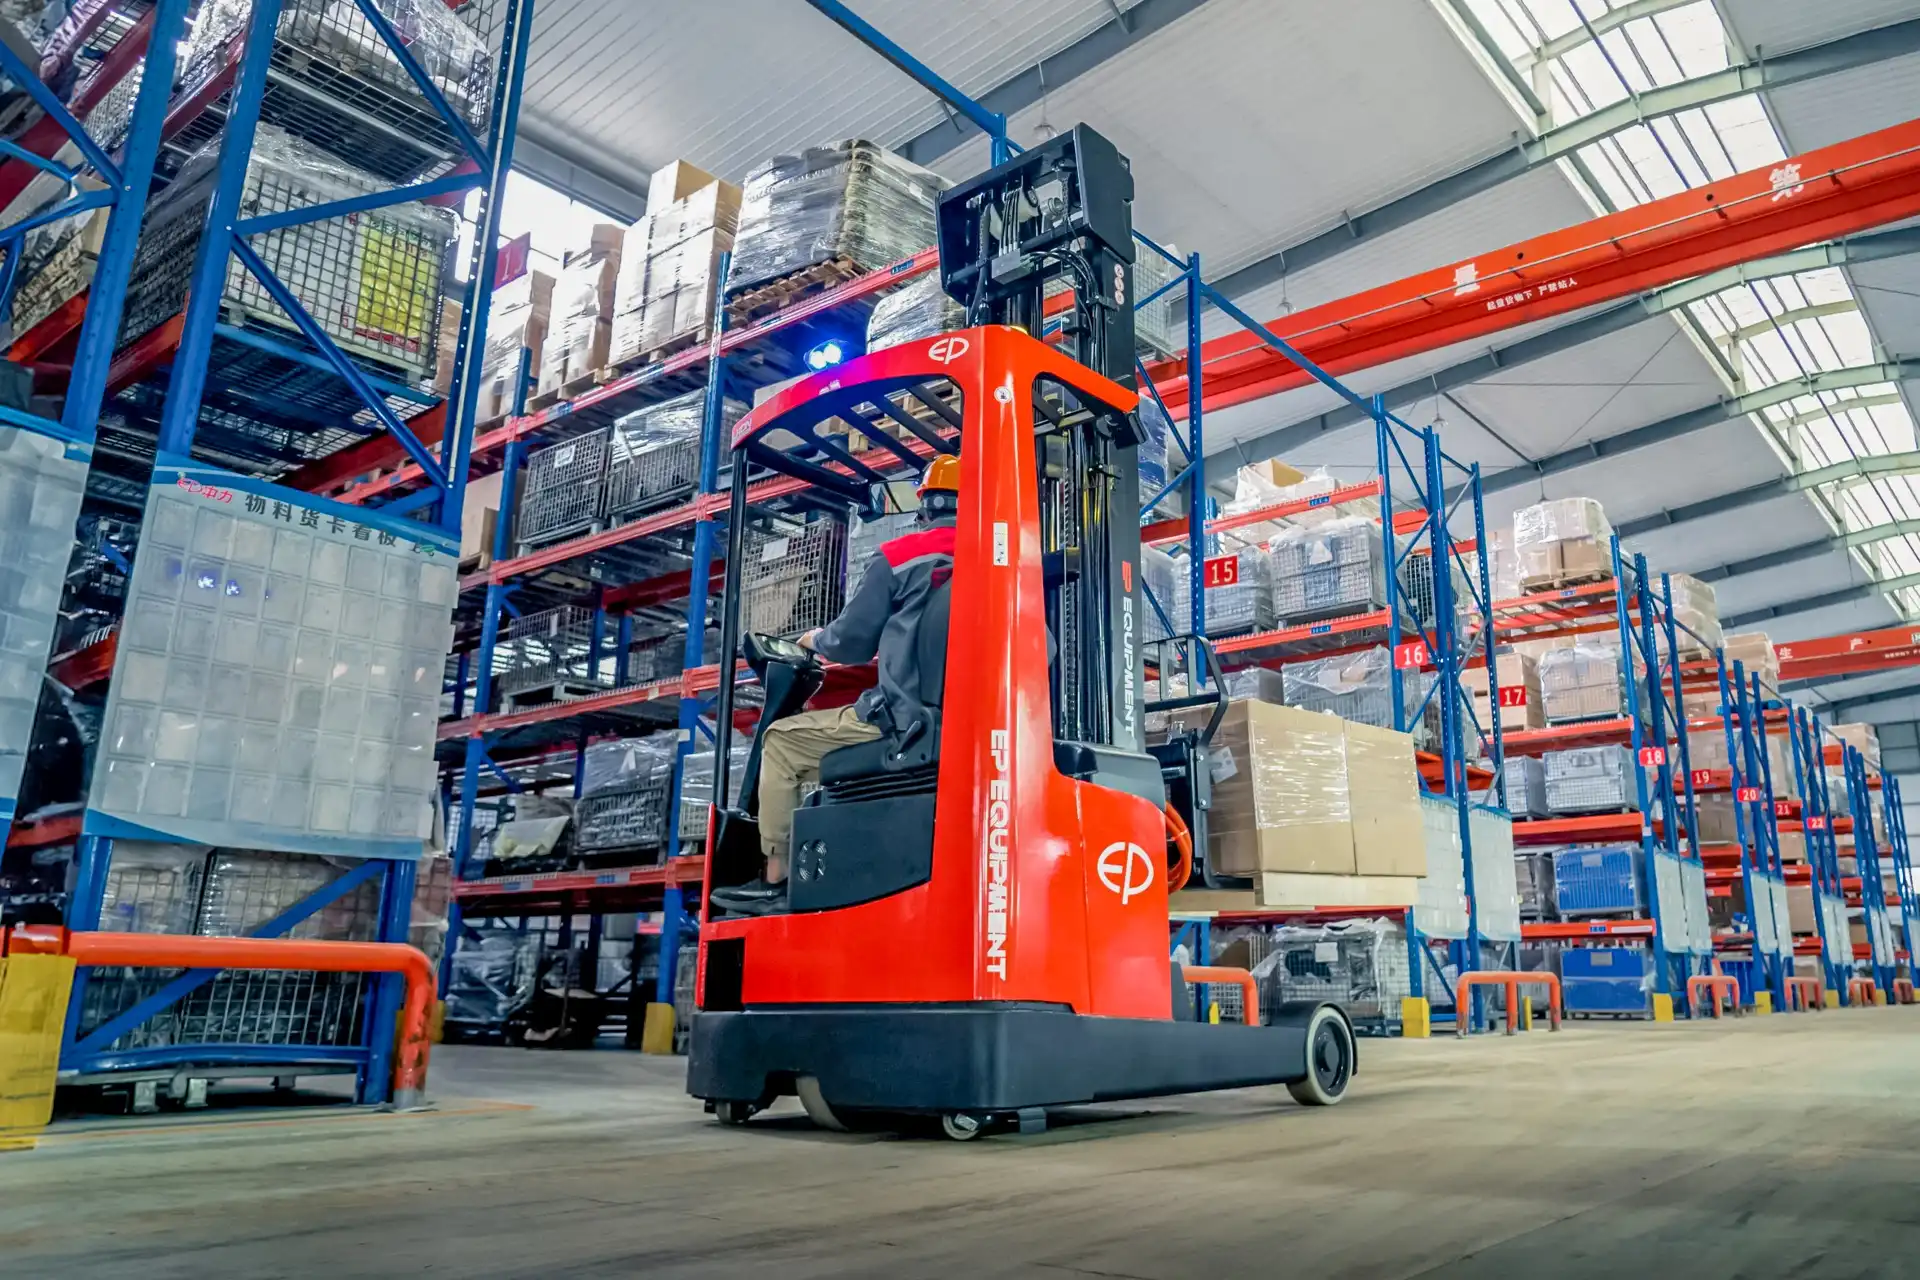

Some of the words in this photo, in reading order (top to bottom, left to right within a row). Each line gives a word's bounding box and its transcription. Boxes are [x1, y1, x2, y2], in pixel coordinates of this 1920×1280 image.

[929, 337, 969, 364] EP
[244, 494, 397, 548] 物料货卡看板
[1122, 561, 1132, 593] EP
[1211, 560, 1233, 584] 15
[1404, 645, 1423, 665] 16
[1124, 597, 1135, 739] EQUIPMENT
[1505, 688, 1522, 705] 17
[990, 729, 1008, 773] EP
[1647, 749, 1662, 765] 18
[1695, 771, 1709, 784] 19
[1743, 788, 1757, 801] 20
[1777, 804, 1790, 816] 21
[987, 779, 1009, 981] EQUIPMENT
[1097, 841, 1154, 905] EP
